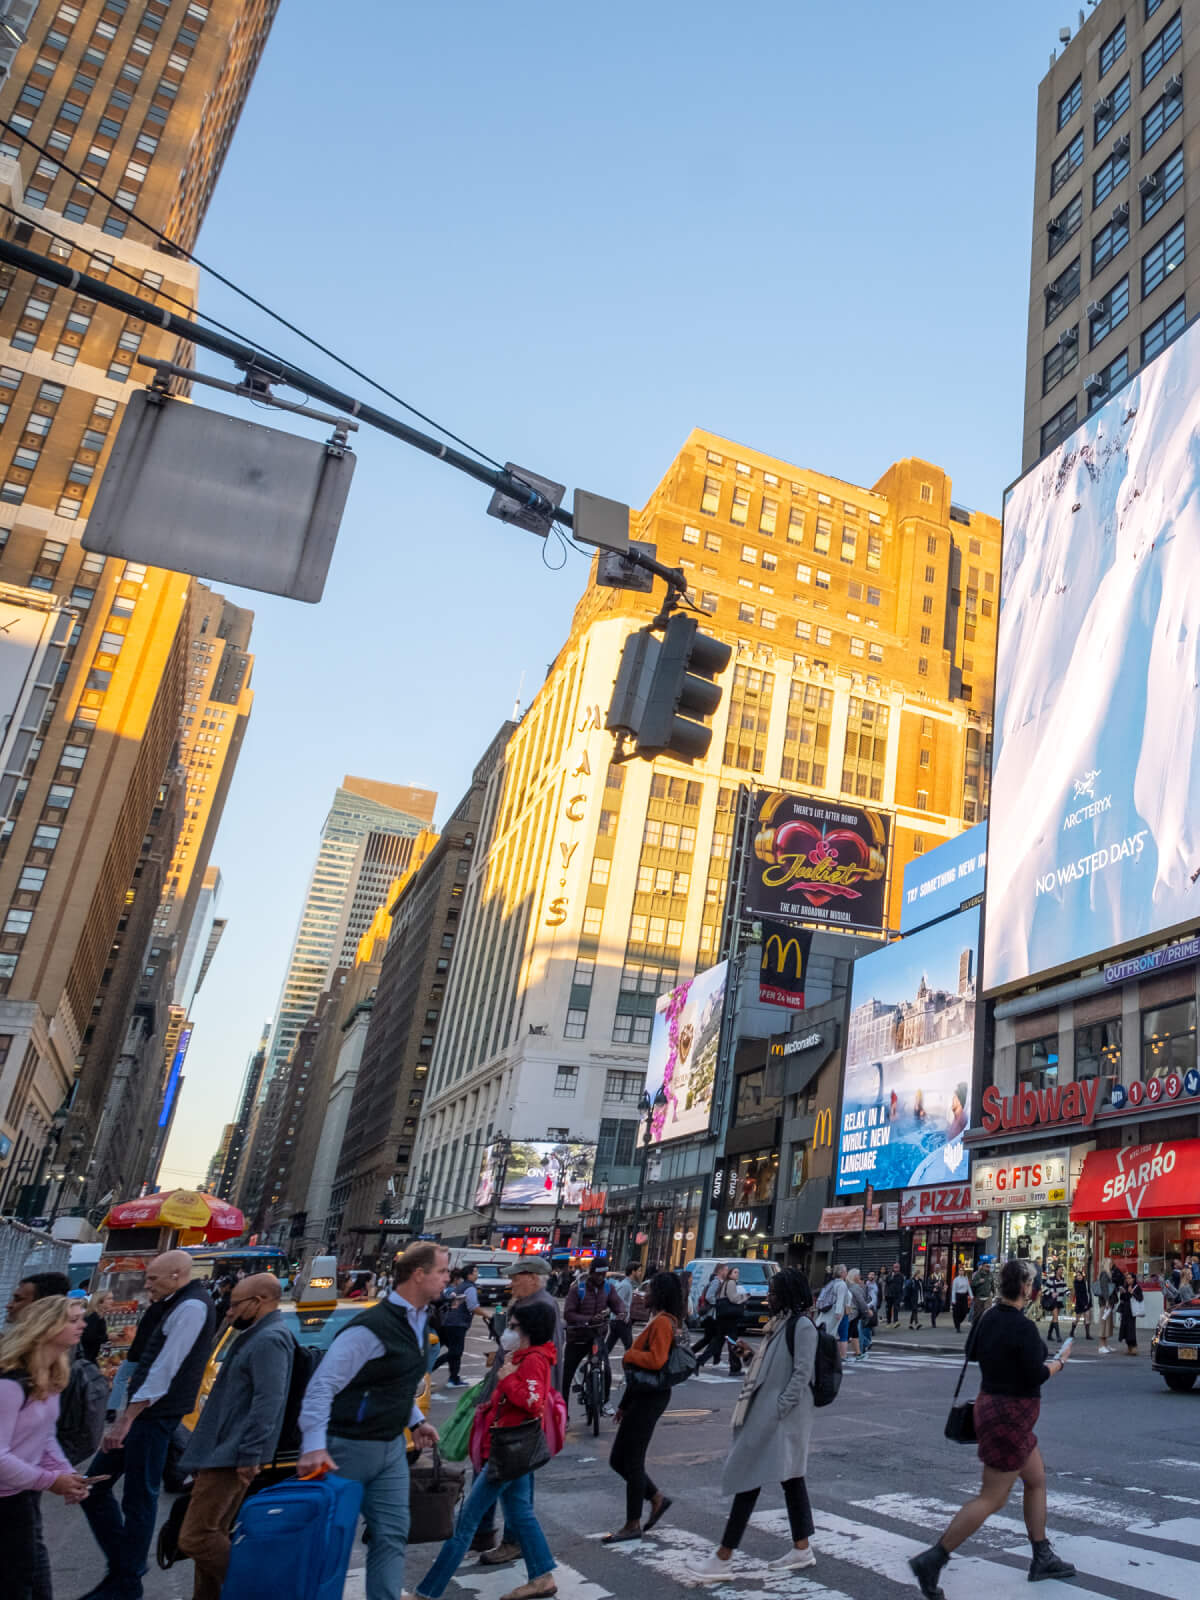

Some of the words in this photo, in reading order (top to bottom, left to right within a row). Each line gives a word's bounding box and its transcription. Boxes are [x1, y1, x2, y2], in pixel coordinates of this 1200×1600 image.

[762, 853, 871, 887] Juliet
[907, 887, 919, 904] TRY
[920, 866, 956, 897] SOMETHING
[958, 857, 977, 878] NEW
[1035, 872, 1056, 897] NO
[1056, 849, 1108, 885] WASTED
[780, 902, 790, 912] THE
[801, 906, 829, 918] BROADWAY
[830, 909, 851, 921] MUSICAL
[760, 990, 776, 999] PEN
[784, 1033, 822, 1056] McDonald's
[981, 1076, 1101, 1133] Subway
[844, 1110, 866, 1131] RELAX
[868, 1107, 878, 1126] IN
[879, 1105, 885, 1124] A
[843, 1131, 867, 1152] WHOLE
[870, 1126, 890, 1147] NEW
[840, 1151, 877, 1174] LANGUAGE
[1101, 1149, 1176, 1203] SBARRO
[920, 1187, 971, 1213] PIZZA
